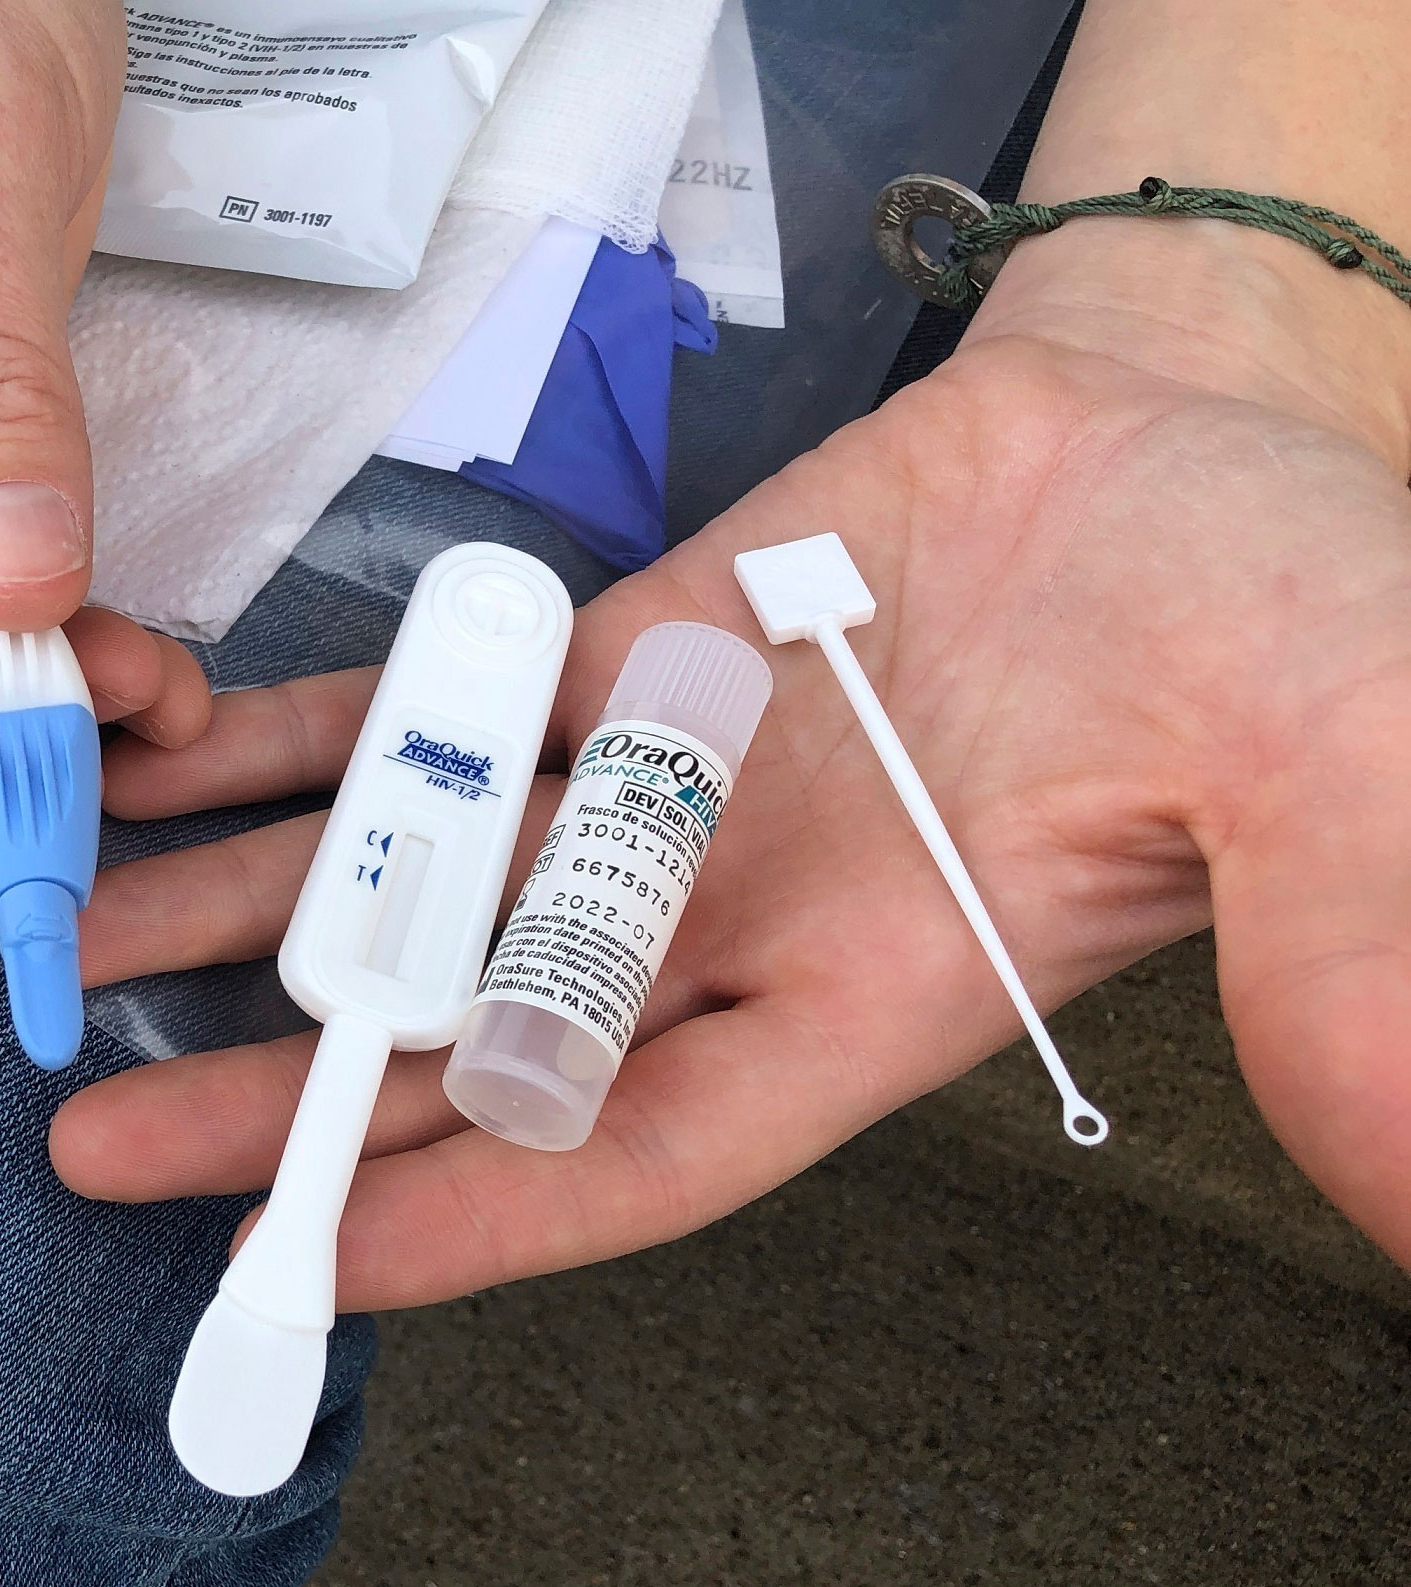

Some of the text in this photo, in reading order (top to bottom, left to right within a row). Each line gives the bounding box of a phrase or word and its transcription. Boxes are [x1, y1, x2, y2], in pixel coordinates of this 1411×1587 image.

[126, 20, 162, 33] mana
[165, 27, 189, 37] tipo
[211, 35, 236, 47] tipo
[238, 42, 248, 50] 2
[248, 43, 306, 53] (VIH-1/2)
[327, 43, 388, 51] muestras
[137, 33, 217, 54] venopunción
[219, 50, 228, 58] y
[228, 53, 278, 62] plasma.
[234, 31, 251, 39] un
[127, 46, 372, 78] Siga las instrucciones al pie de la letra.
[178, 94, 243, 108] inexactos.
[180, 83, 205, 94] que
[207, 87, 225, 95] no
[261, 88, 281, 97] los
[284, 91, 357, 111] aprobados
[228, 203, 332, 227] PN 3001-1197
[405, 731, 494, 771] OraQuick
[426, 775, 481, 801] HIV-1/2
[623, 788, 659, 810] DEV
[663, 805, 687, 832] SOL
[367, 830, 377, 846] C
[577, 804, 619, 819] Frasco
[622, 811, 639, 825] de
[641, 819, 687, 858] solución
[357, 864, 367, 881] T
[532, 857, 670, 916] OT 6675876
[521, 914, 538, 923] use
[540, 913, 566, 925] with
[567, 918, 588, 931] the
[589, 926, 644, 966] associated
[552, 892, 655, 949] 2022-07
[516, 938, 536, 946] con
[537, 938, 552, 948] el
[551, 940, 613, 974] dispositivo
[614, 972, 641, 1008] asociado
[553, 927, 581, 941] date
[580, 937, 623, 963] printed
[621, 961, 634, 974] on
[633, 970, 644, 987] the
[496, 963, 544, 978] OraSure
[548, 968, 623, 1026] Technologies,
[512, 948, 526, 957] de
[527, 950, 591, 975] caducidad
[590, 969, 627, 1003] impresa
[626, 1000, 635, 1015] en
[489, 978, 625, 1054] Bethlehem, PA 18015 USA
